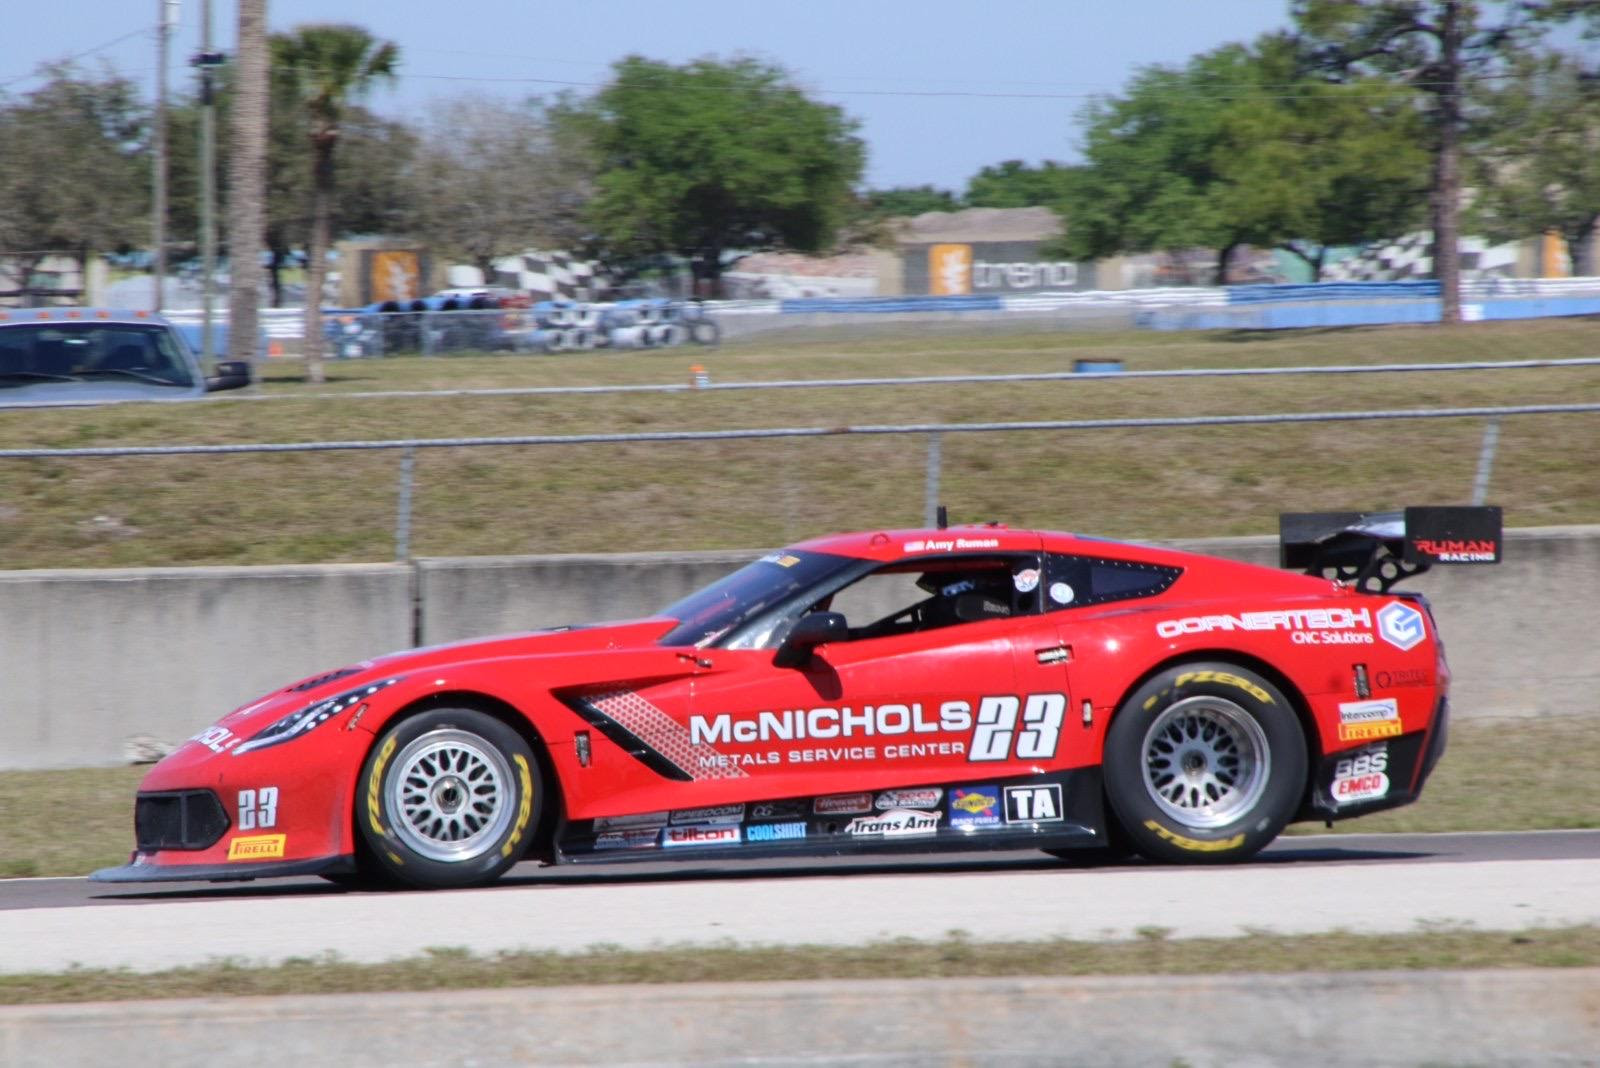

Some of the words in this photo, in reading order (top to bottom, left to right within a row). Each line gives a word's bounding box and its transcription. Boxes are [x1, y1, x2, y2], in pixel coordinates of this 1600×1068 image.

[925, 539, 954, 551] Amy
[956, 538, 999, 549] Ruman
[1413, 540, 1496, 555] RUMAN
[1438, 552, 1496, 561] RACING
[1292, 632, 1322, 644] CNC
[1322, 631, 1374, 644] Solutions
[690, 700, 972, 746] McNICHOLS
[967, 692, 1068, 762] 23
[1341, 723, 1402, 740] PIRELLI
[700, 751, 780, 768] METALS
[788, 745, 876, 763] SERVICE
[884, 742, 966, 759] CENTER
[1338, 775, 1381, 795] EMCO
[238, 786, 278, 831] 23
[1010, 788, 1056, 819] TA
[746, 821, 807, 841] COOLSHIRT
[853, 820, 901, 833] Trans
[903, 816, 936, 829] Am
[669, 827, 735, 842] tilton
[234, 840, 279, 855] PIRELLI
